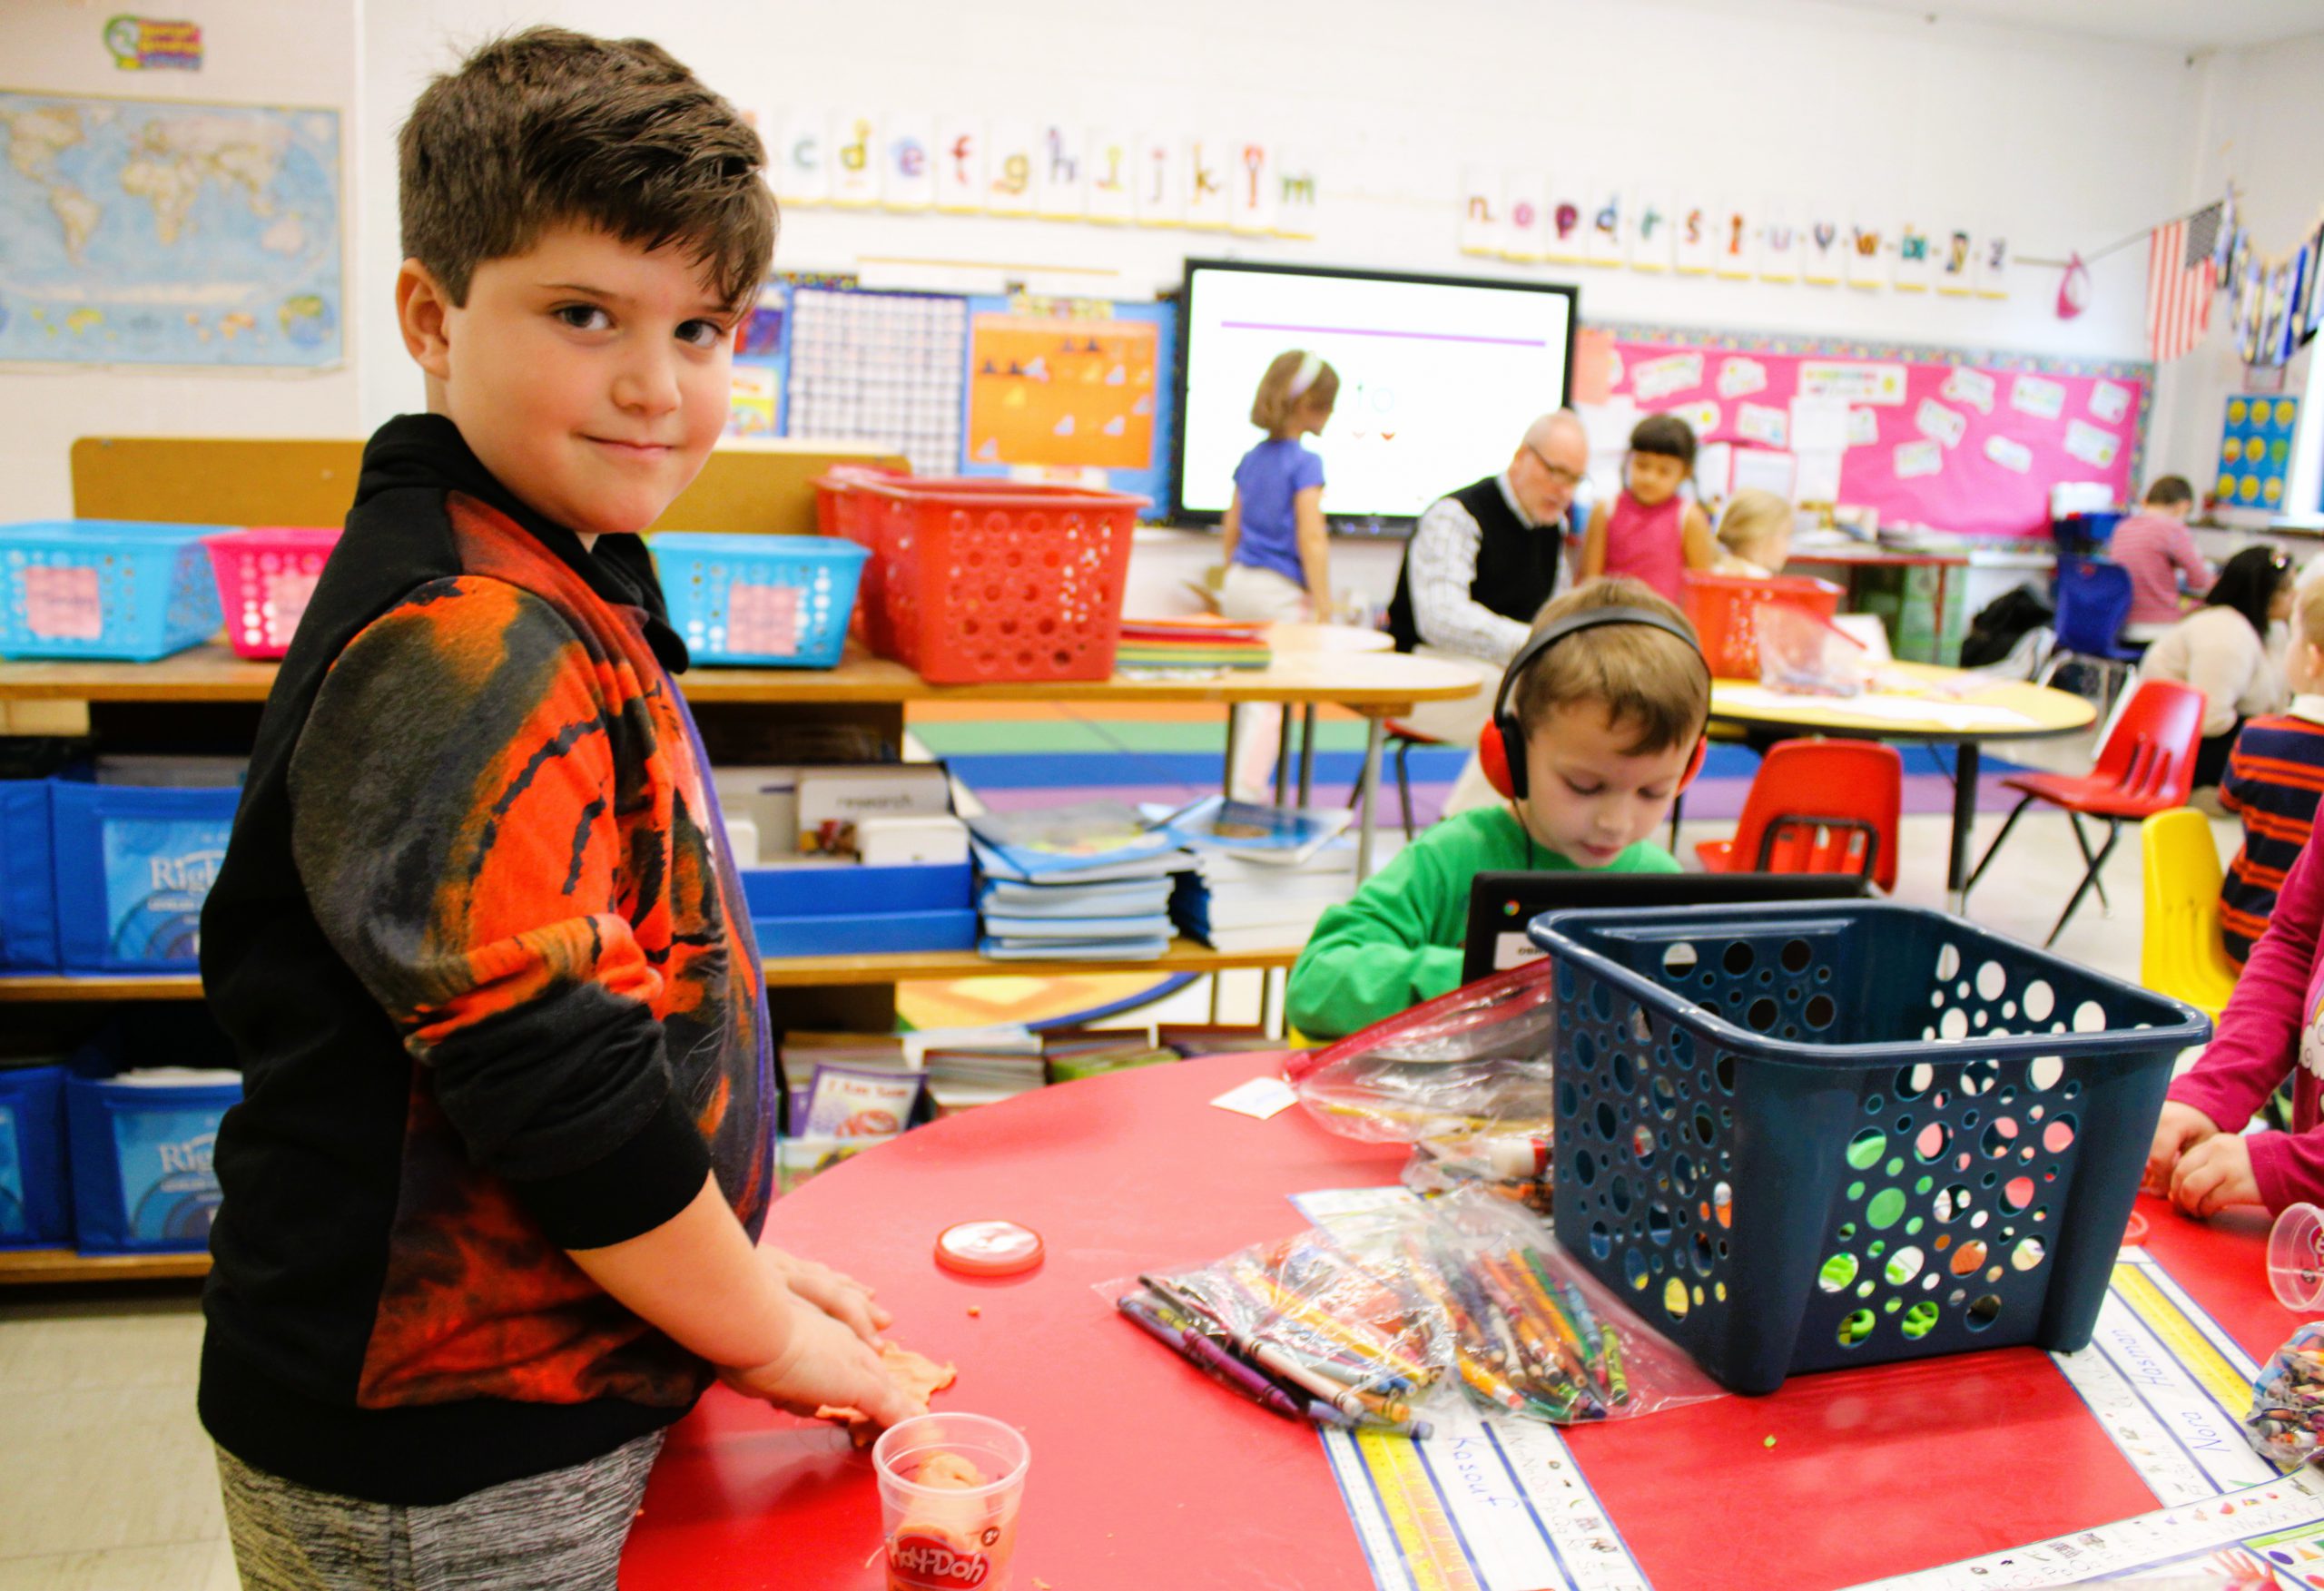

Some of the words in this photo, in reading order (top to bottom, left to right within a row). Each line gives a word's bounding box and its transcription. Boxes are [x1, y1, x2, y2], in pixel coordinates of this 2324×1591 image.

[792, 137, 819, 172] c
[839, 117, 872, 172] d
[950, 134, 971, 185] f
[992, 151, 1030, 195] g
[1047, 127, 1078, 184] h
[1148, 146, 1165, 204] j
[1191, 141, 1221, 206] k
[1280, 172, 1316, 206] m
[1468, 194, 1495, 223] n
[1513, 201, 1535, 231] o
[1555, 201, 1579, 241] p
[1640, 204, 1663, 241] r
[1686, 207, 1701, 246] s
[1770, 224, 1792, 251] u
[1814, 222, 1836, 254] v
[1853, 223, 1879, 256] w
